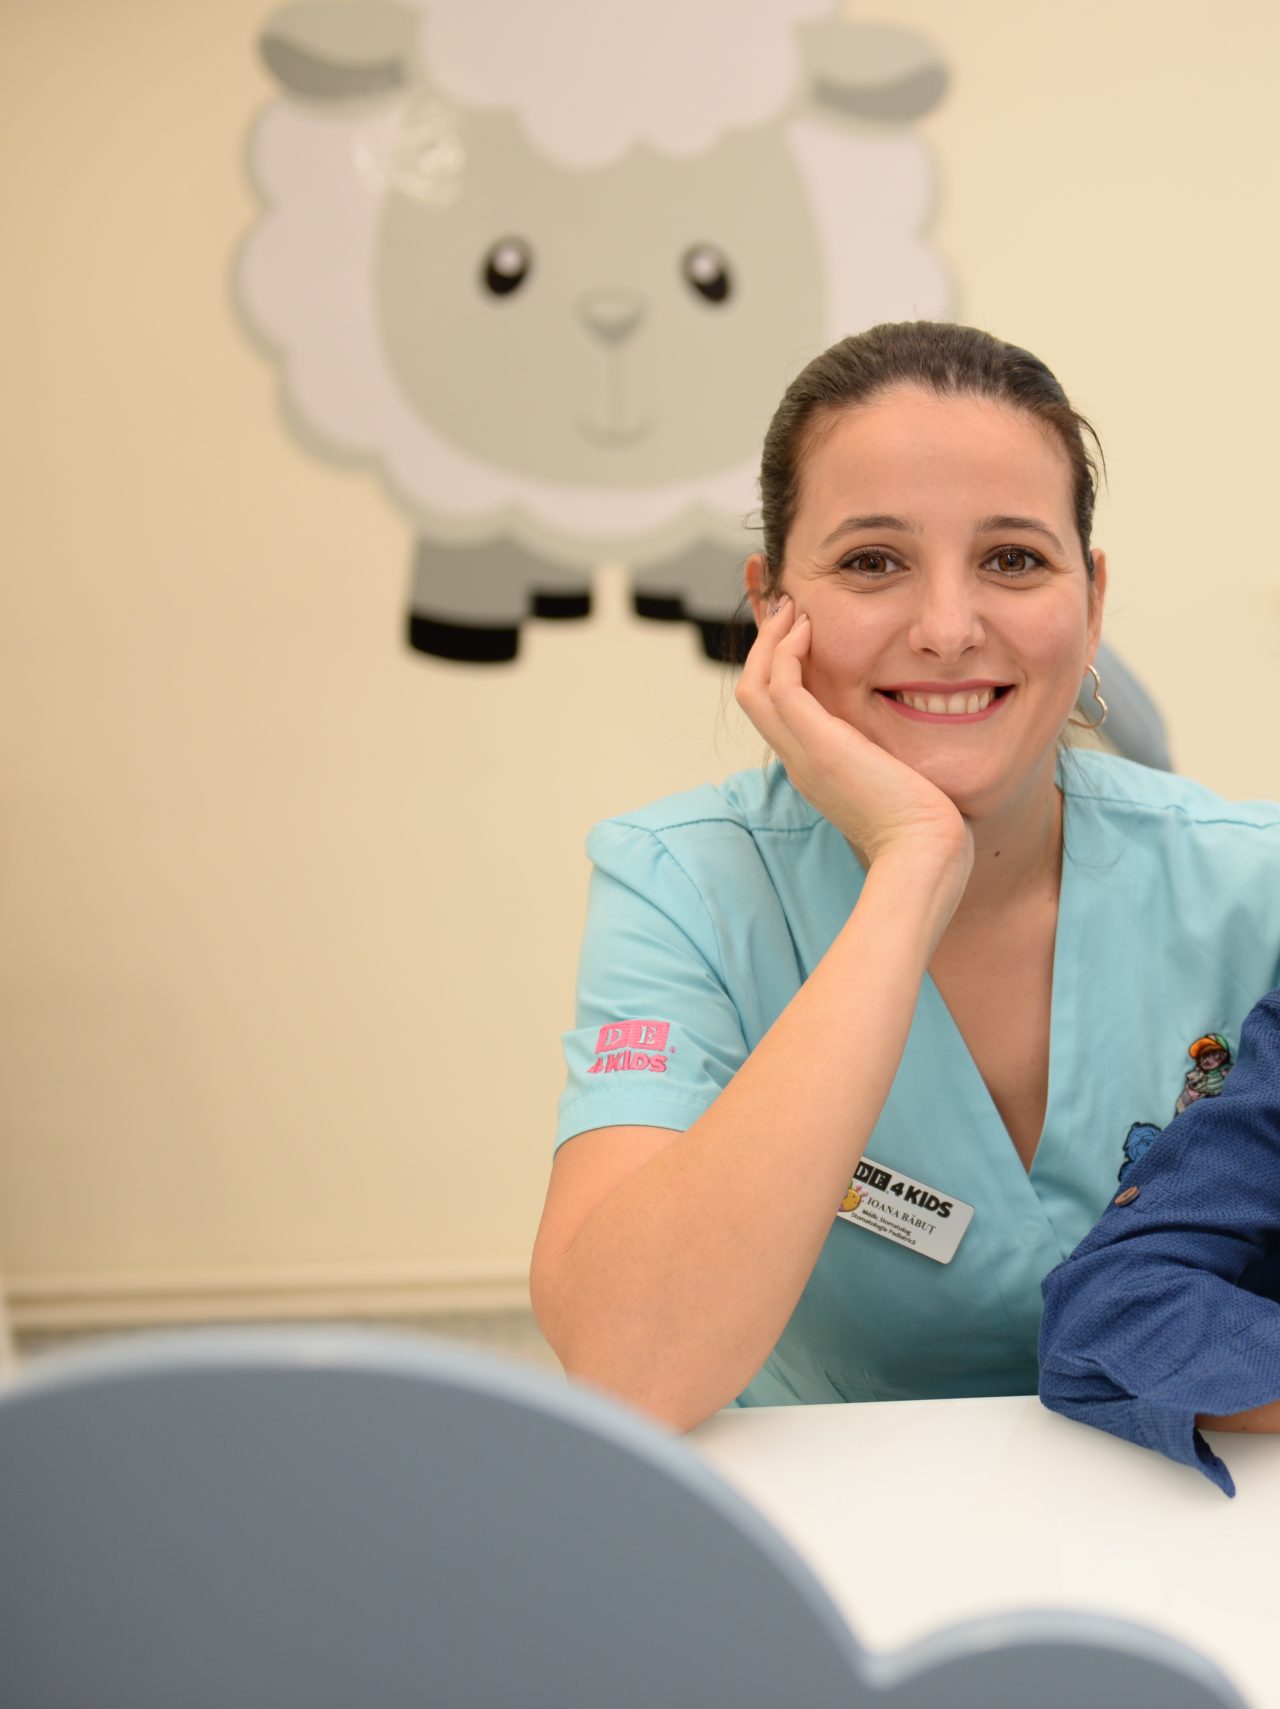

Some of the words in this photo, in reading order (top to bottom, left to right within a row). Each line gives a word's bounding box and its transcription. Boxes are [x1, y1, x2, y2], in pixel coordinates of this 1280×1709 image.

[867, 1197, 899, 1218] IOANA
[851, 1212, 888, 1232] Stomatologie
[862, 1209, 879, 1221] Medic
[879, 1217, 912, 1236] Stomatolog
